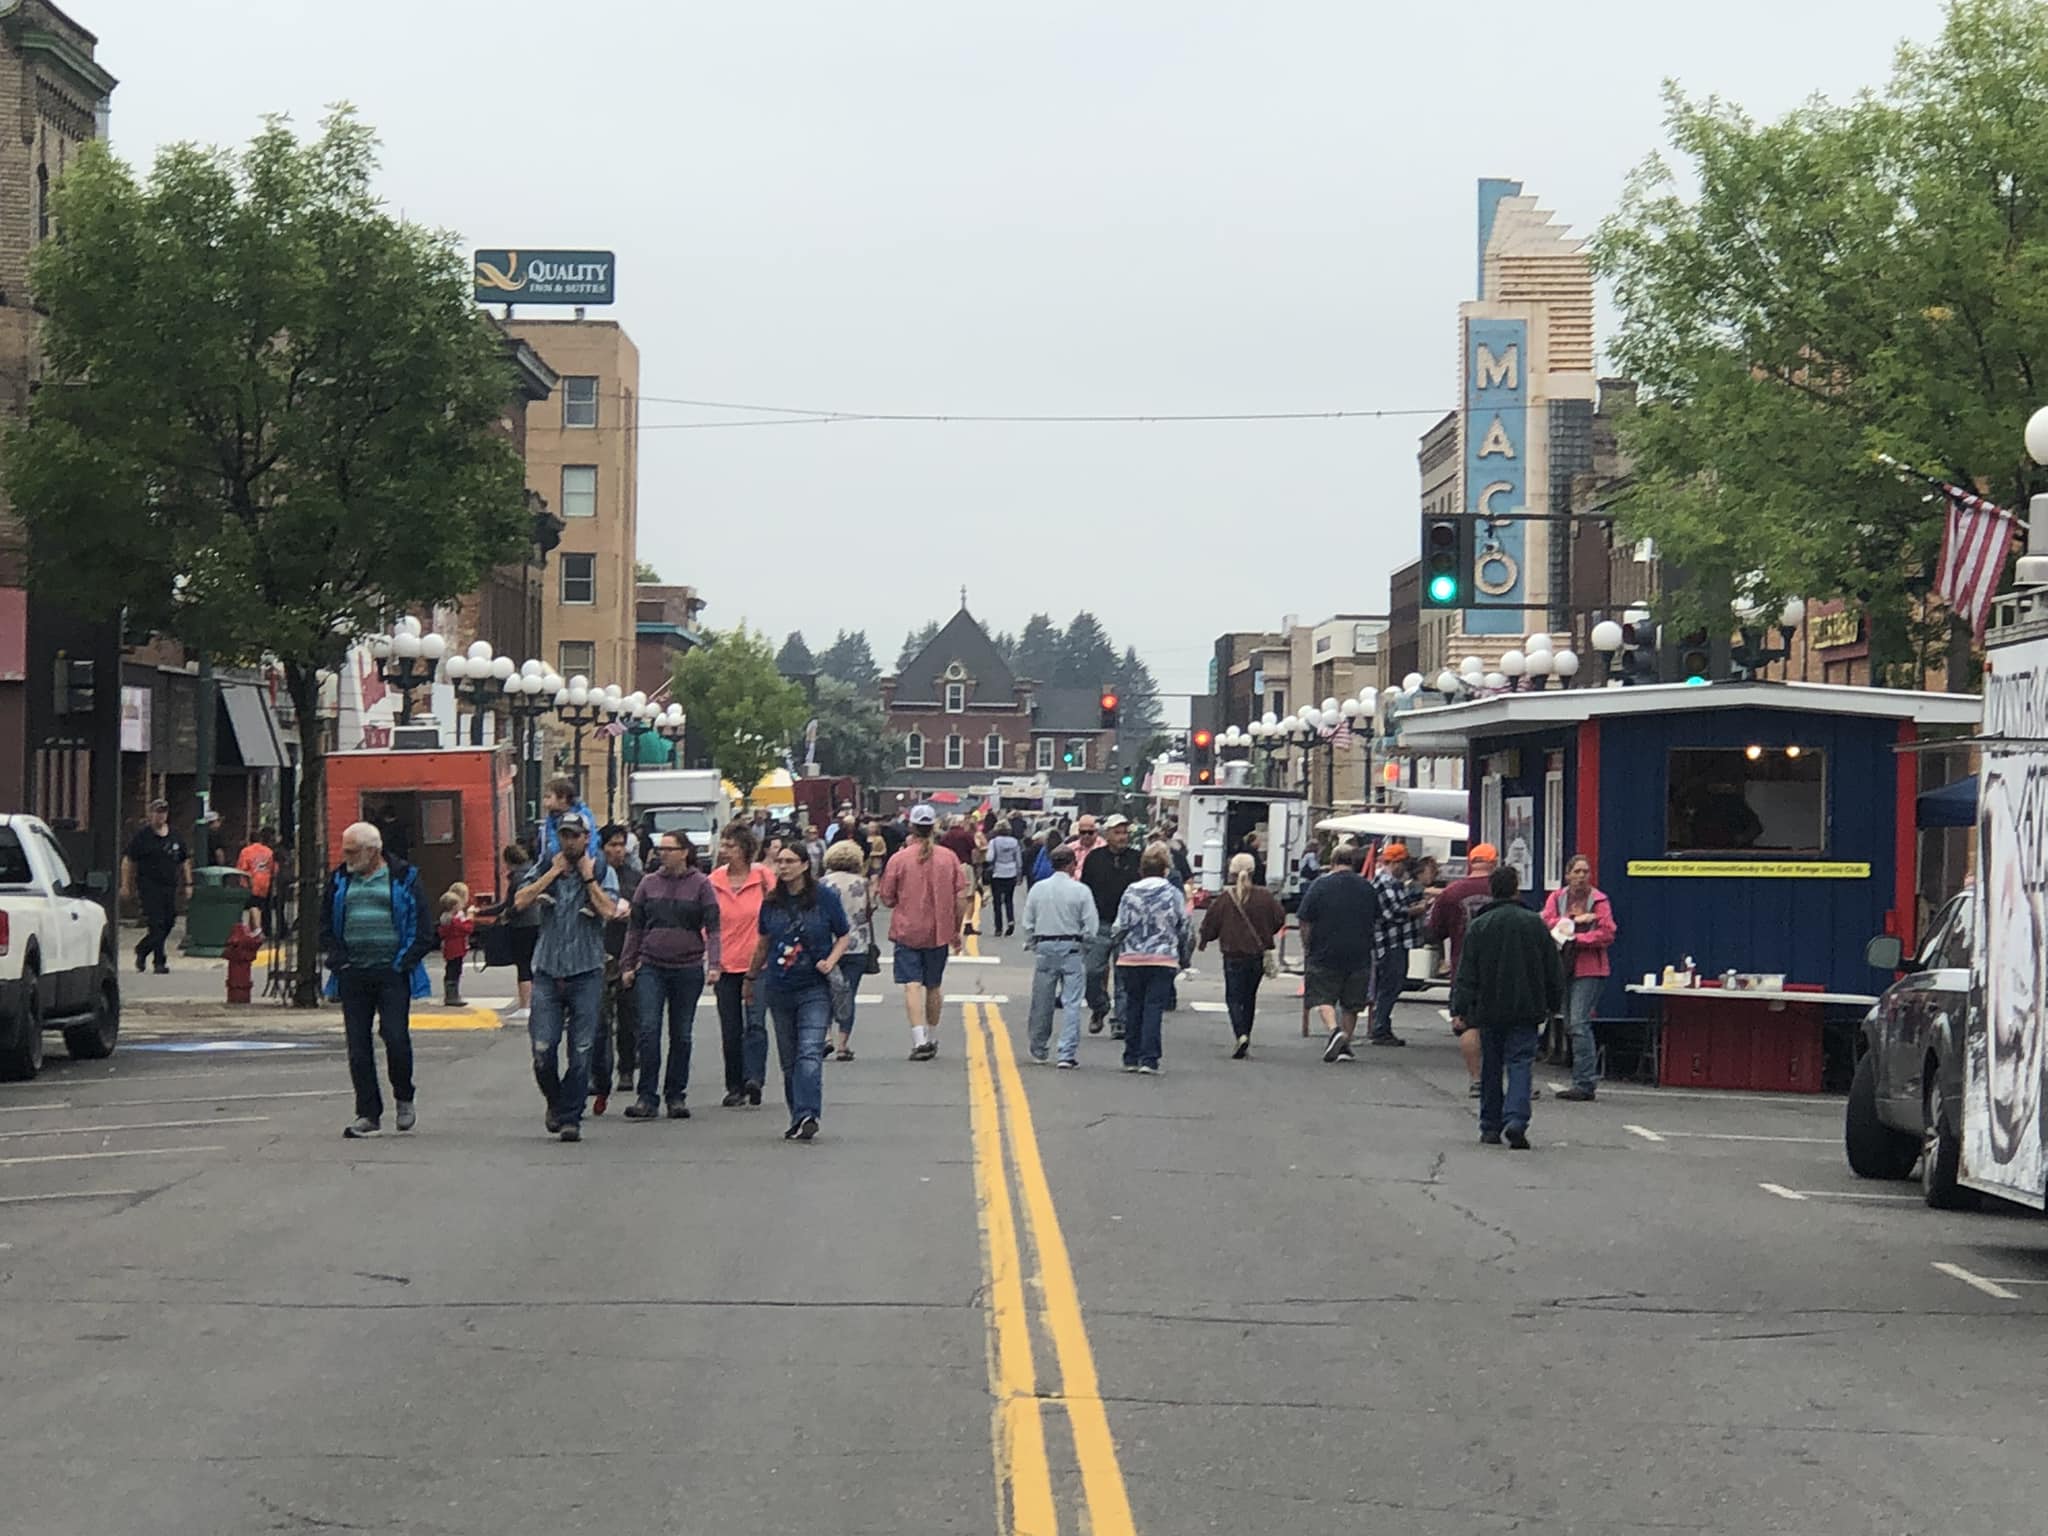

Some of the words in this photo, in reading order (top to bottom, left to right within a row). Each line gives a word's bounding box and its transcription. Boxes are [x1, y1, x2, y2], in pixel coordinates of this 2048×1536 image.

[528, 259, 608, 283] QUALITY
[529, 284, 552, 293] INN
[554, 283, 563, 293] &
[564, 283, 607, 294] SUITES
[1474, 342, 1519, 596] MACO
